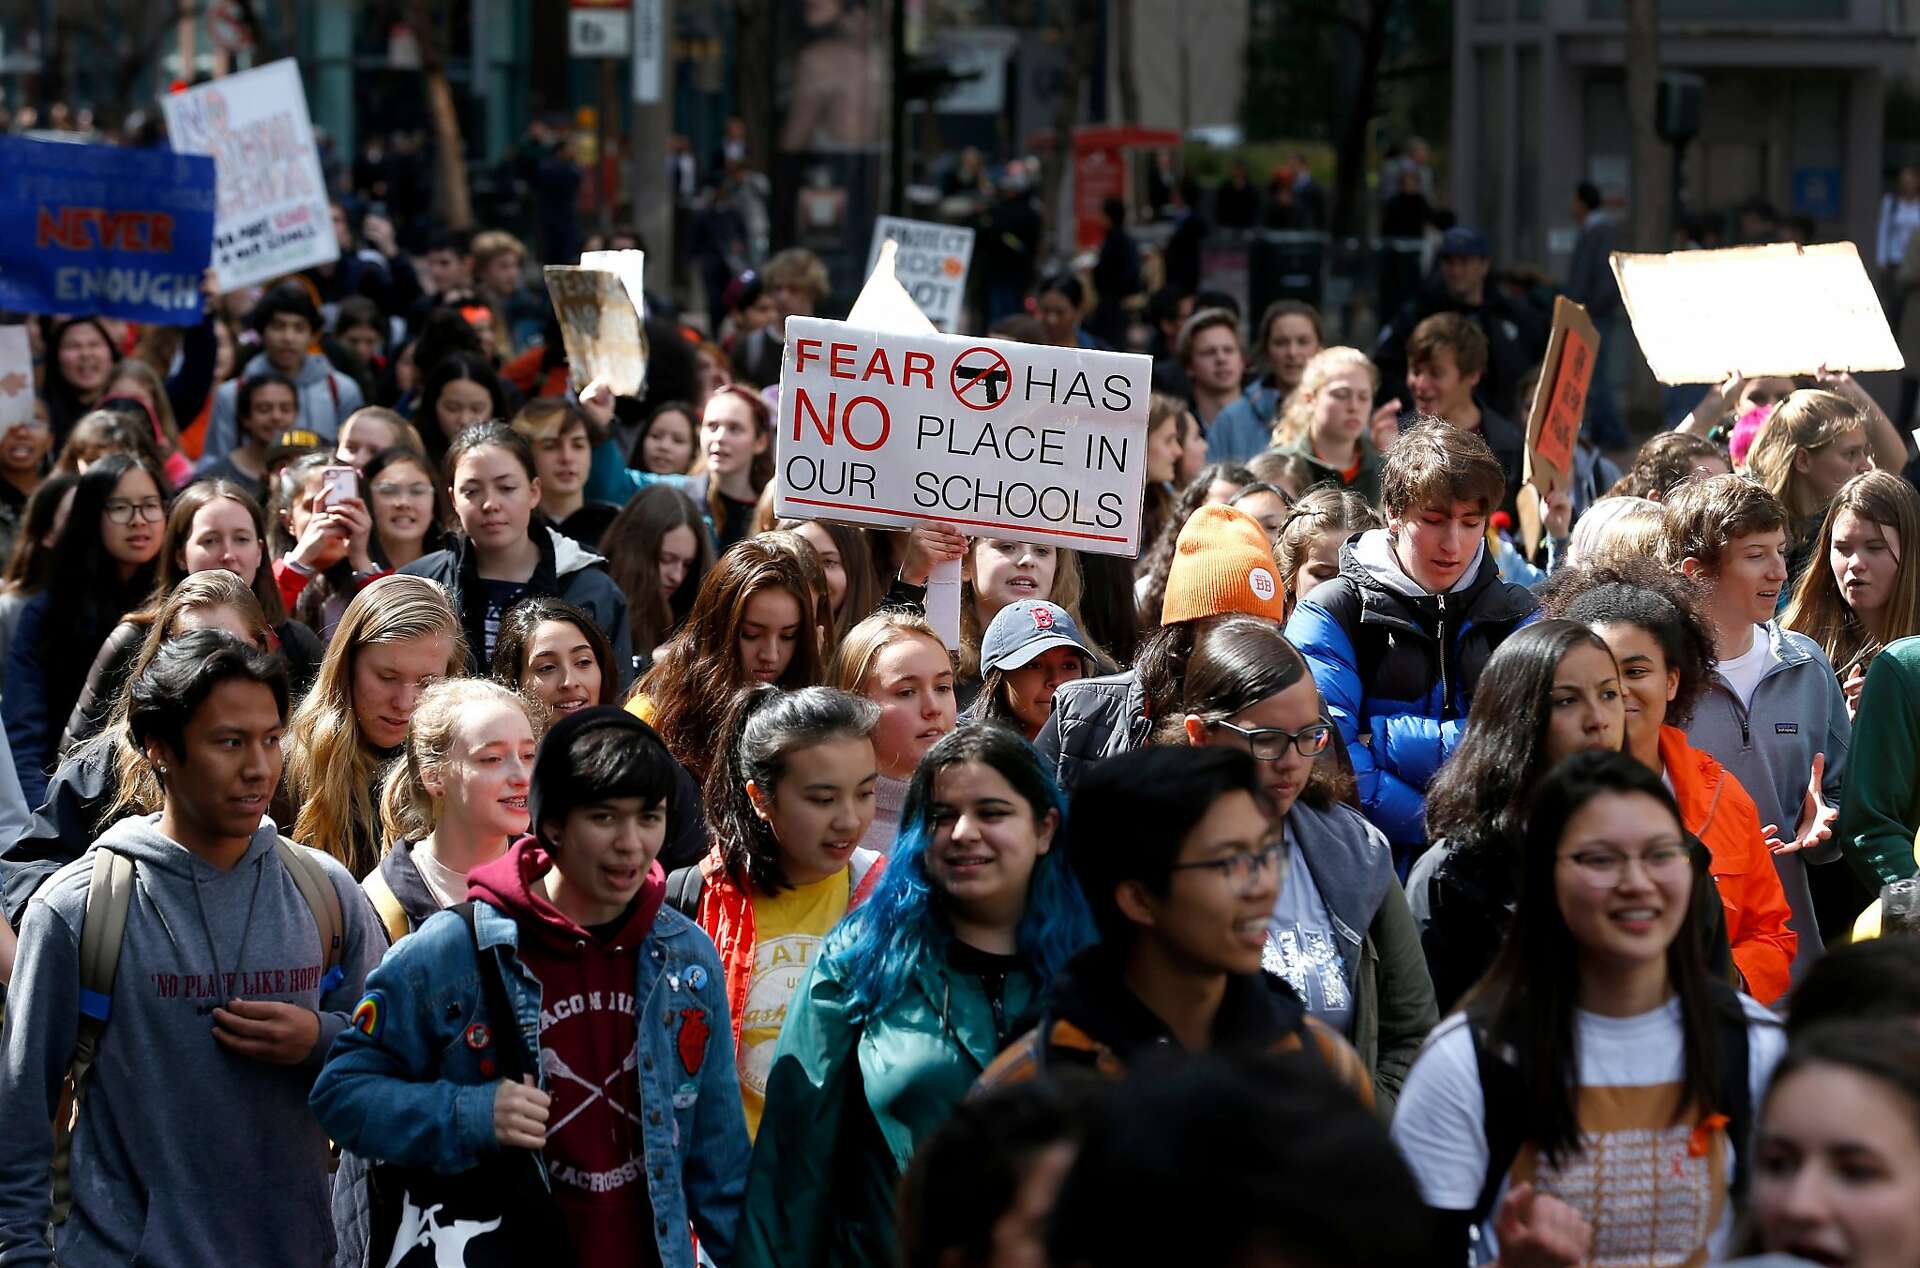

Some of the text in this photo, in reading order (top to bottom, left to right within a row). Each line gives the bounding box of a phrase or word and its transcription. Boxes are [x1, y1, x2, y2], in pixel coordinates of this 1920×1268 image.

[36, 203, 176, 253] NEVER
[898, 252, 944, 278] IDS
[54, 266, 198, 310] ENOUGH
[904, 280, 953, 311] OT
[796, 338, 1132, 412] FEAR HAS
[793, 387, 1128, 473] NO PLACE IN
[786, 455, 1123, 529] OUR SCHOOLS
[1256, 578, 1271, 592] BB
[1030, 607, 1053, 629] B
[242, 969, 284, 995] LIKE
[540, 990, 602, 1034] ACON
